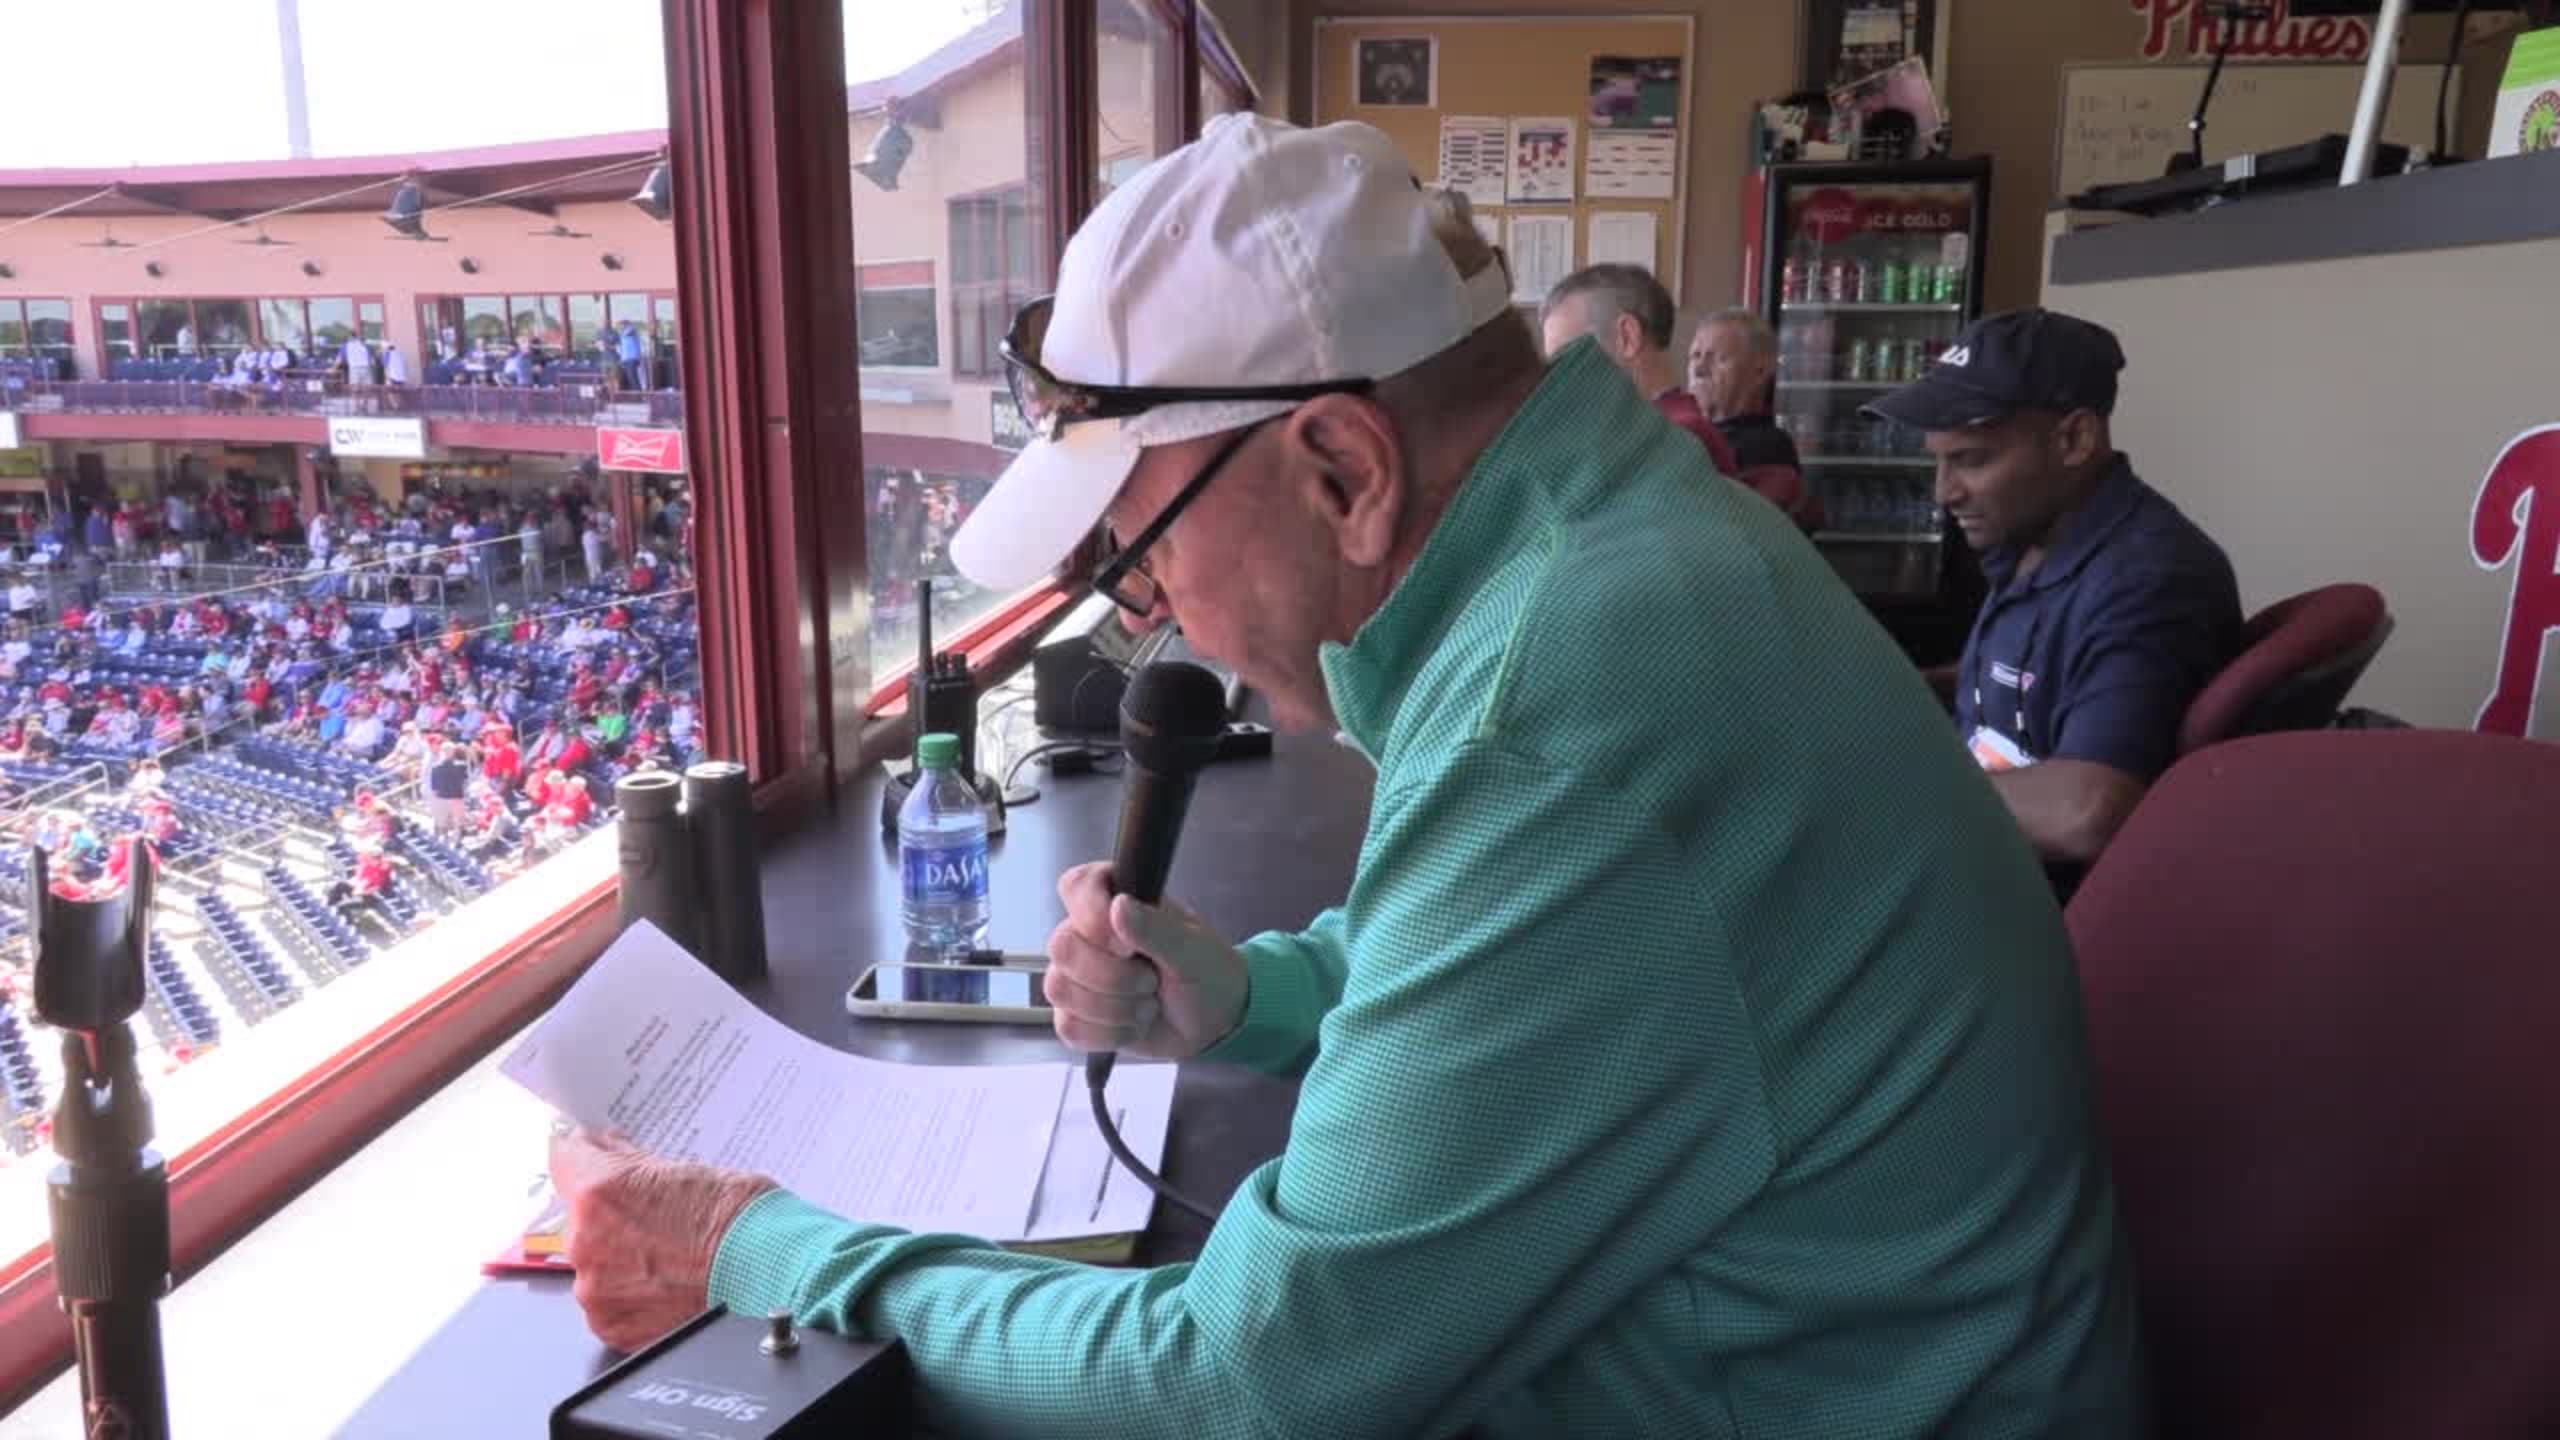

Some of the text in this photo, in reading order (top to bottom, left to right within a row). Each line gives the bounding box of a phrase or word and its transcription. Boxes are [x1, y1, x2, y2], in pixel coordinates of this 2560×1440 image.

[926, 854, 987, 889] DASA
[629, 1382, 769, 1422] Sign Off
